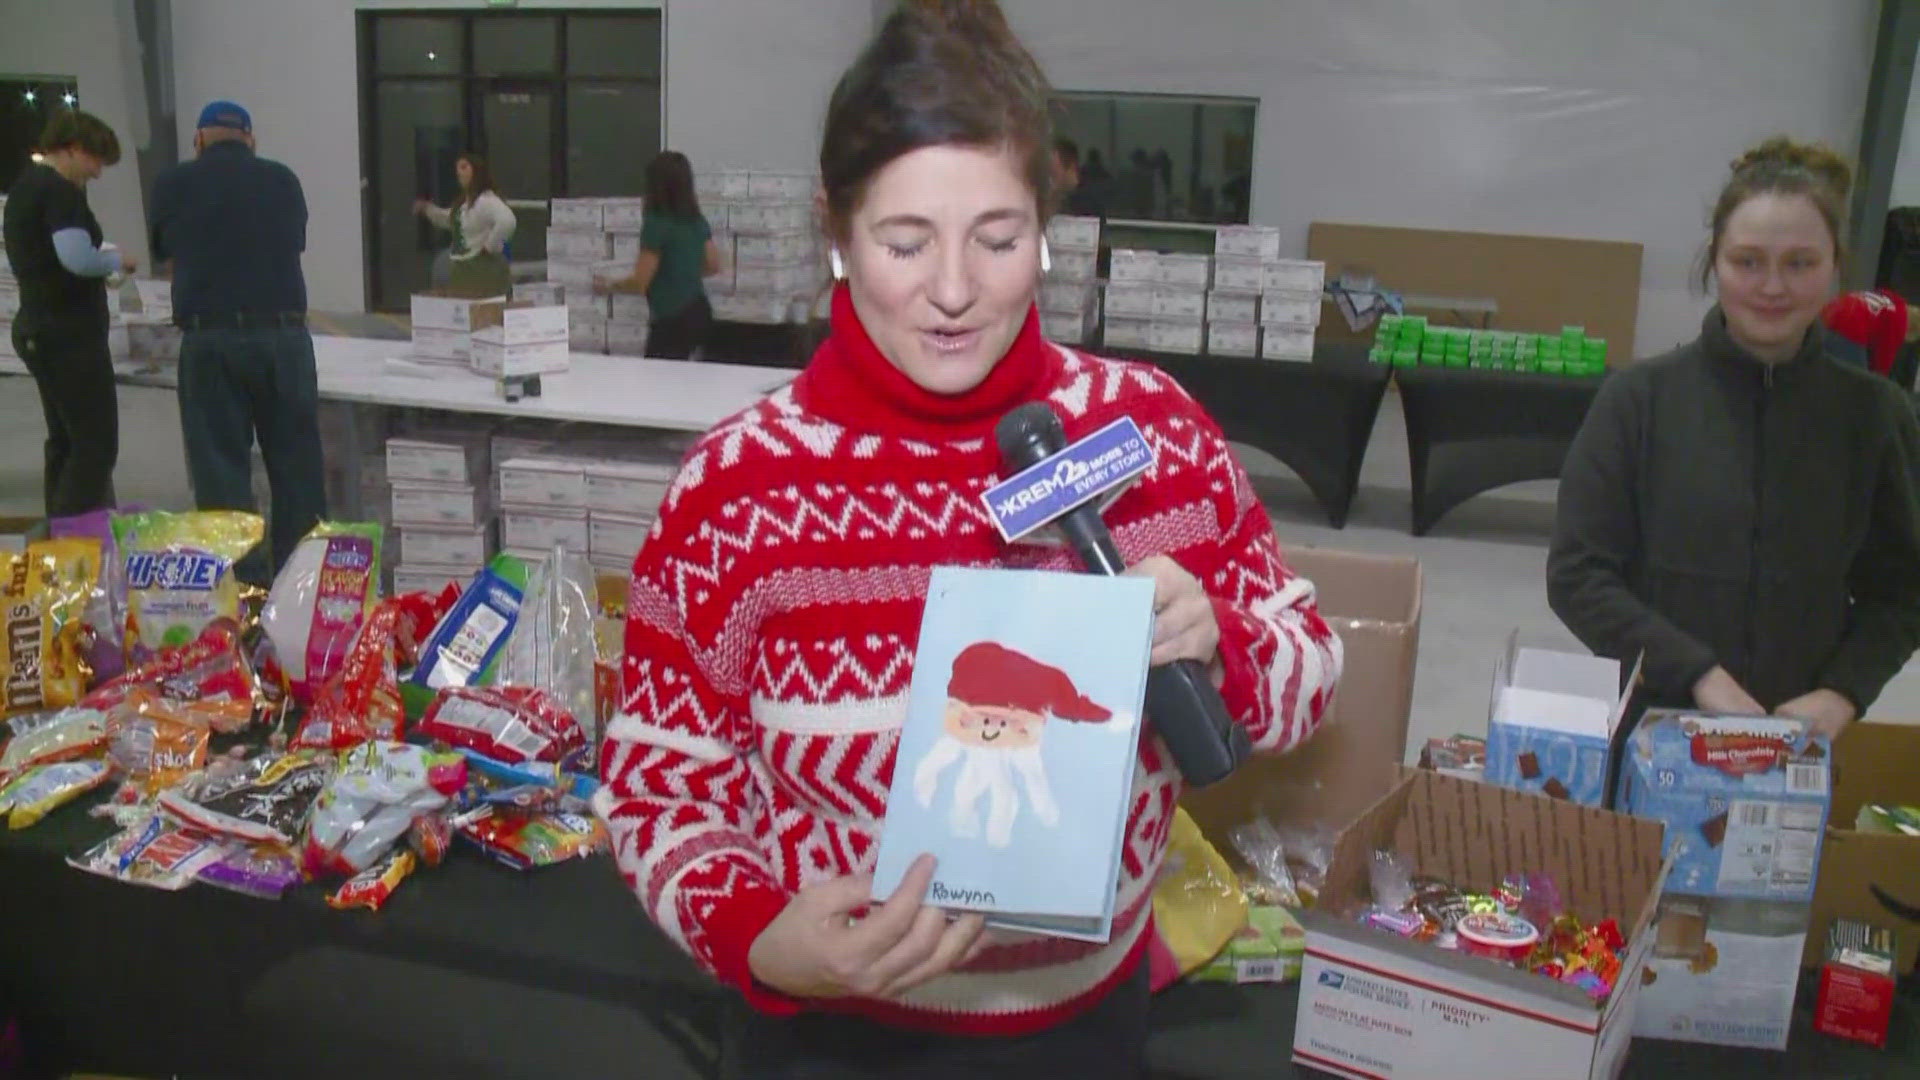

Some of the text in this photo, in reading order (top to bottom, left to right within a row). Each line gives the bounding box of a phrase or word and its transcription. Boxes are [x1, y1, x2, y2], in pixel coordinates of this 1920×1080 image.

[1090, 438, 1140, 471] MORE TO
[1074, 448, 1147, 496] EVERY STORY
[1707, 747, 1775, 761] Milk Chocolate
[1658, 771, 1675, 786] 50
[932, 881, 996, 905] Rowynn
[1349, 1011, 1370, 1024] FLAT
[1371, 1018, 1393, 1031] RATE
[1394, 1026, 1413, 1037] BOX
[1442, 1014, 1471, 1029] MAIL
